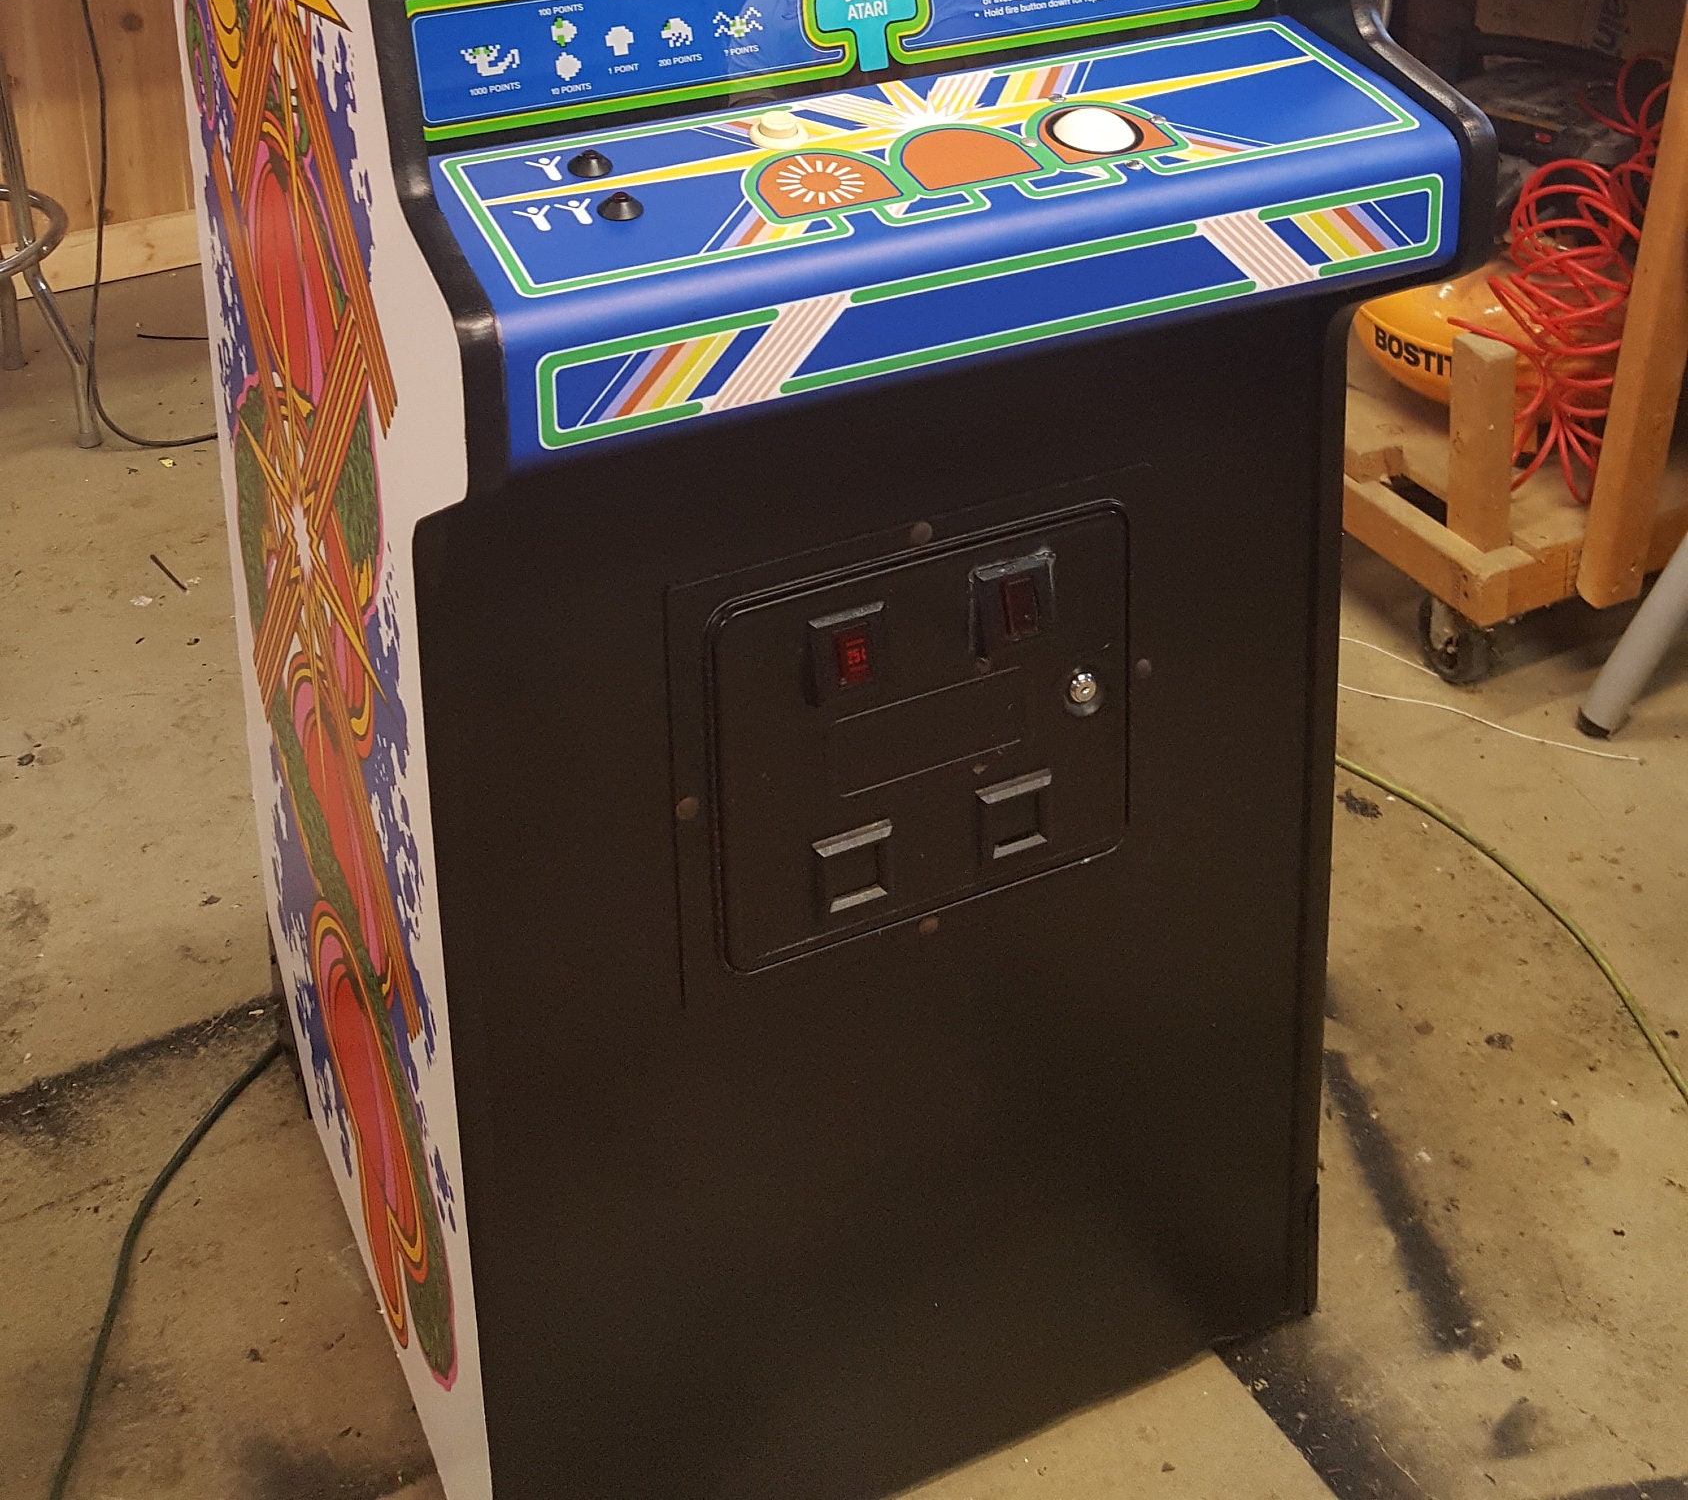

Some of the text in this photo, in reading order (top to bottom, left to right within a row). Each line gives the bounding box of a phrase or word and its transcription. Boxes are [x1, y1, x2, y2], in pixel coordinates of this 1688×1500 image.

[538, 3, 585, 16] 100 POINTS
[847, 0, 888, 21] ATARI
[983, 6, 1004, 18] Hold
[1005, 4, 1019, 15] fire
[1020, 1, 1047, 12] button
[730, 44, 760, 56] POINTS
[658, 53, 703, 67] 200 POINTS
[614, 63, 640, 74] POINT
[470, 82, 521, 96] 1000 POINTS
[551, 82, 592, 95] 10 POINTS
